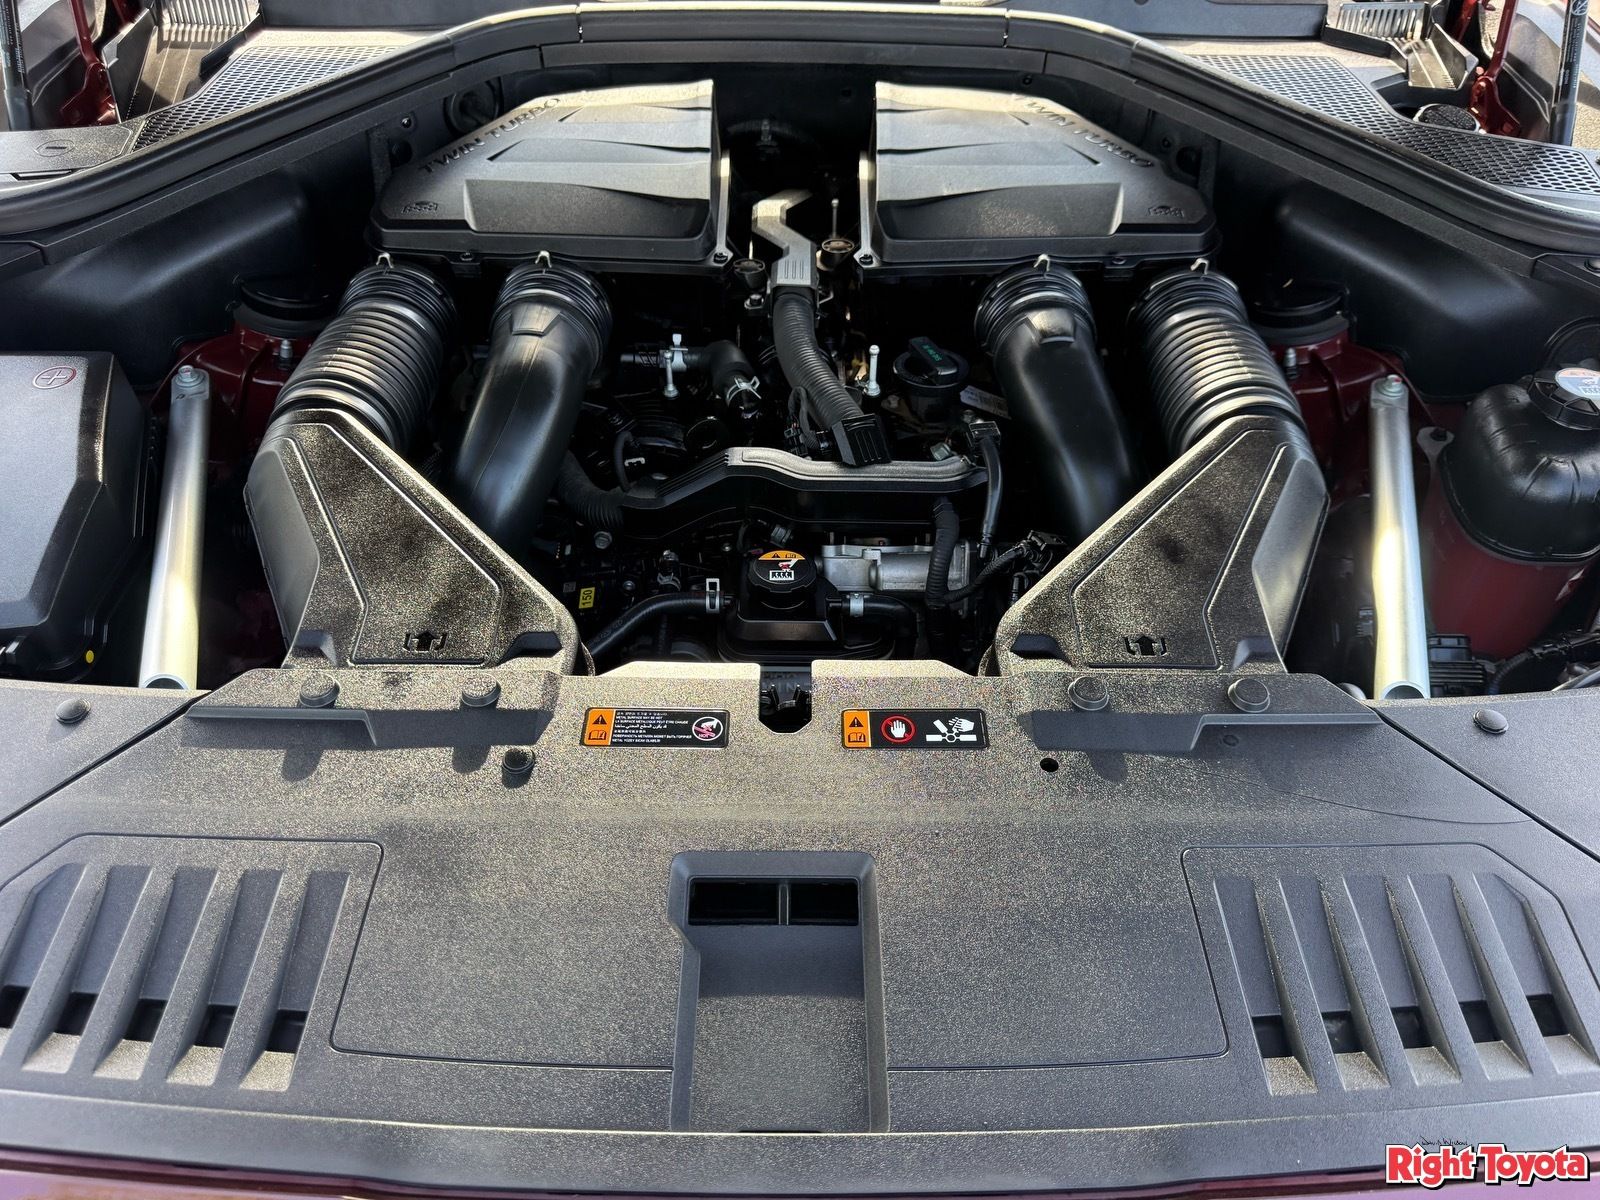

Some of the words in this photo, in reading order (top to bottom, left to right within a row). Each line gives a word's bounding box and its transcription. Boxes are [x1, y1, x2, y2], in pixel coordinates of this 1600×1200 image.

[417, 137, 486, 174] TWIN
[485, 98, 561, 138] TURBO
[581, 589, 593, 606] 150
